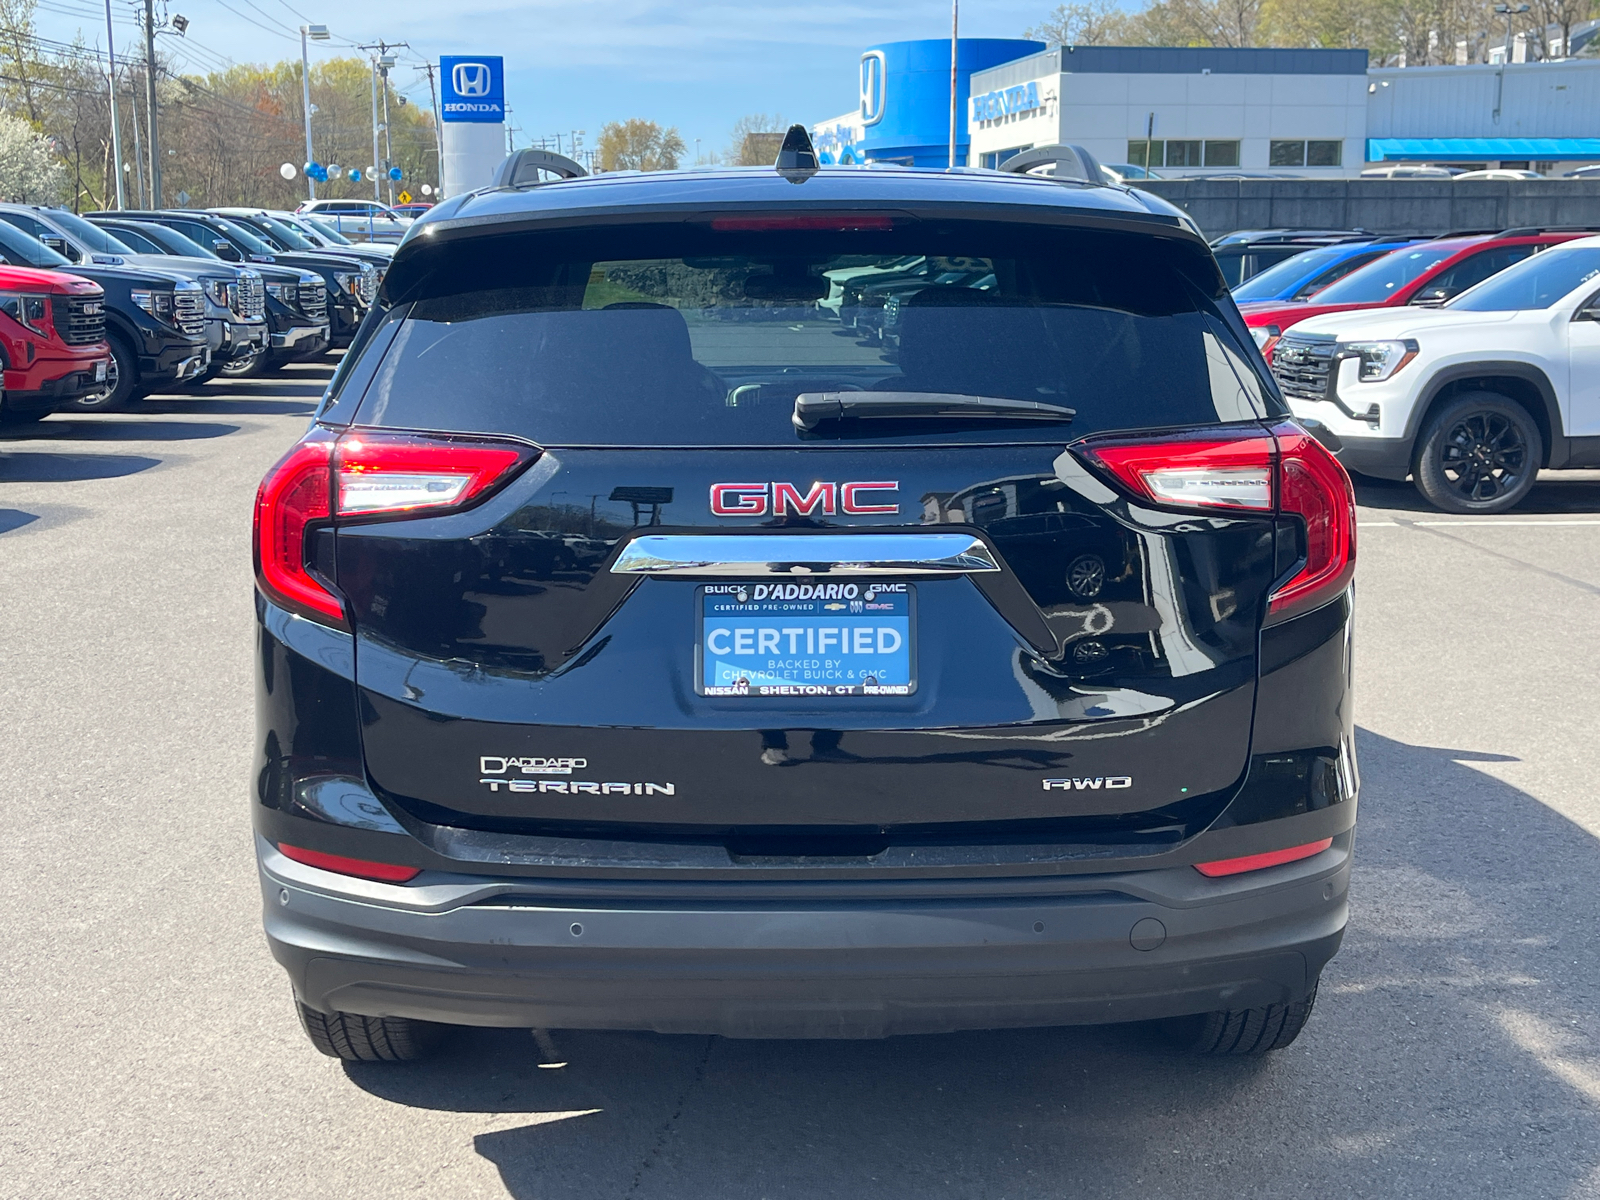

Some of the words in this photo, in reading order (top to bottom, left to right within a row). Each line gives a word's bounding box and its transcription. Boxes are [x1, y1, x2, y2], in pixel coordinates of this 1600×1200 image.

[444, 103, 501, 112] HONDA
[973, 81, 1040, 122] HONDA
[710, 481, 899, 516] GMC
[704, 585, 747, 593] BUICK
[753, 583, 859, 600] D'ADDARIO
[869, 583, 907, 592] GMC
[707, 627, 902, 656] CERTIFIED
[768, 659, 820, 669] BACKED
[825, 659, 841, 669] BY
[722, 670, 799, 680] CHEVROLET
[804, 670, 843, 679] BUICK
[846, 670, 855, 679] &
[859, 669, 887, 679] GMC
[704, 686, 748, 695] NISSAN
[759, 686, 832, 695] SHELTON,
[835, 686, 855, 694] CT
[480, 778, 675, 796] TERRAIN
[1042, 776, 1132, 791] AWD
